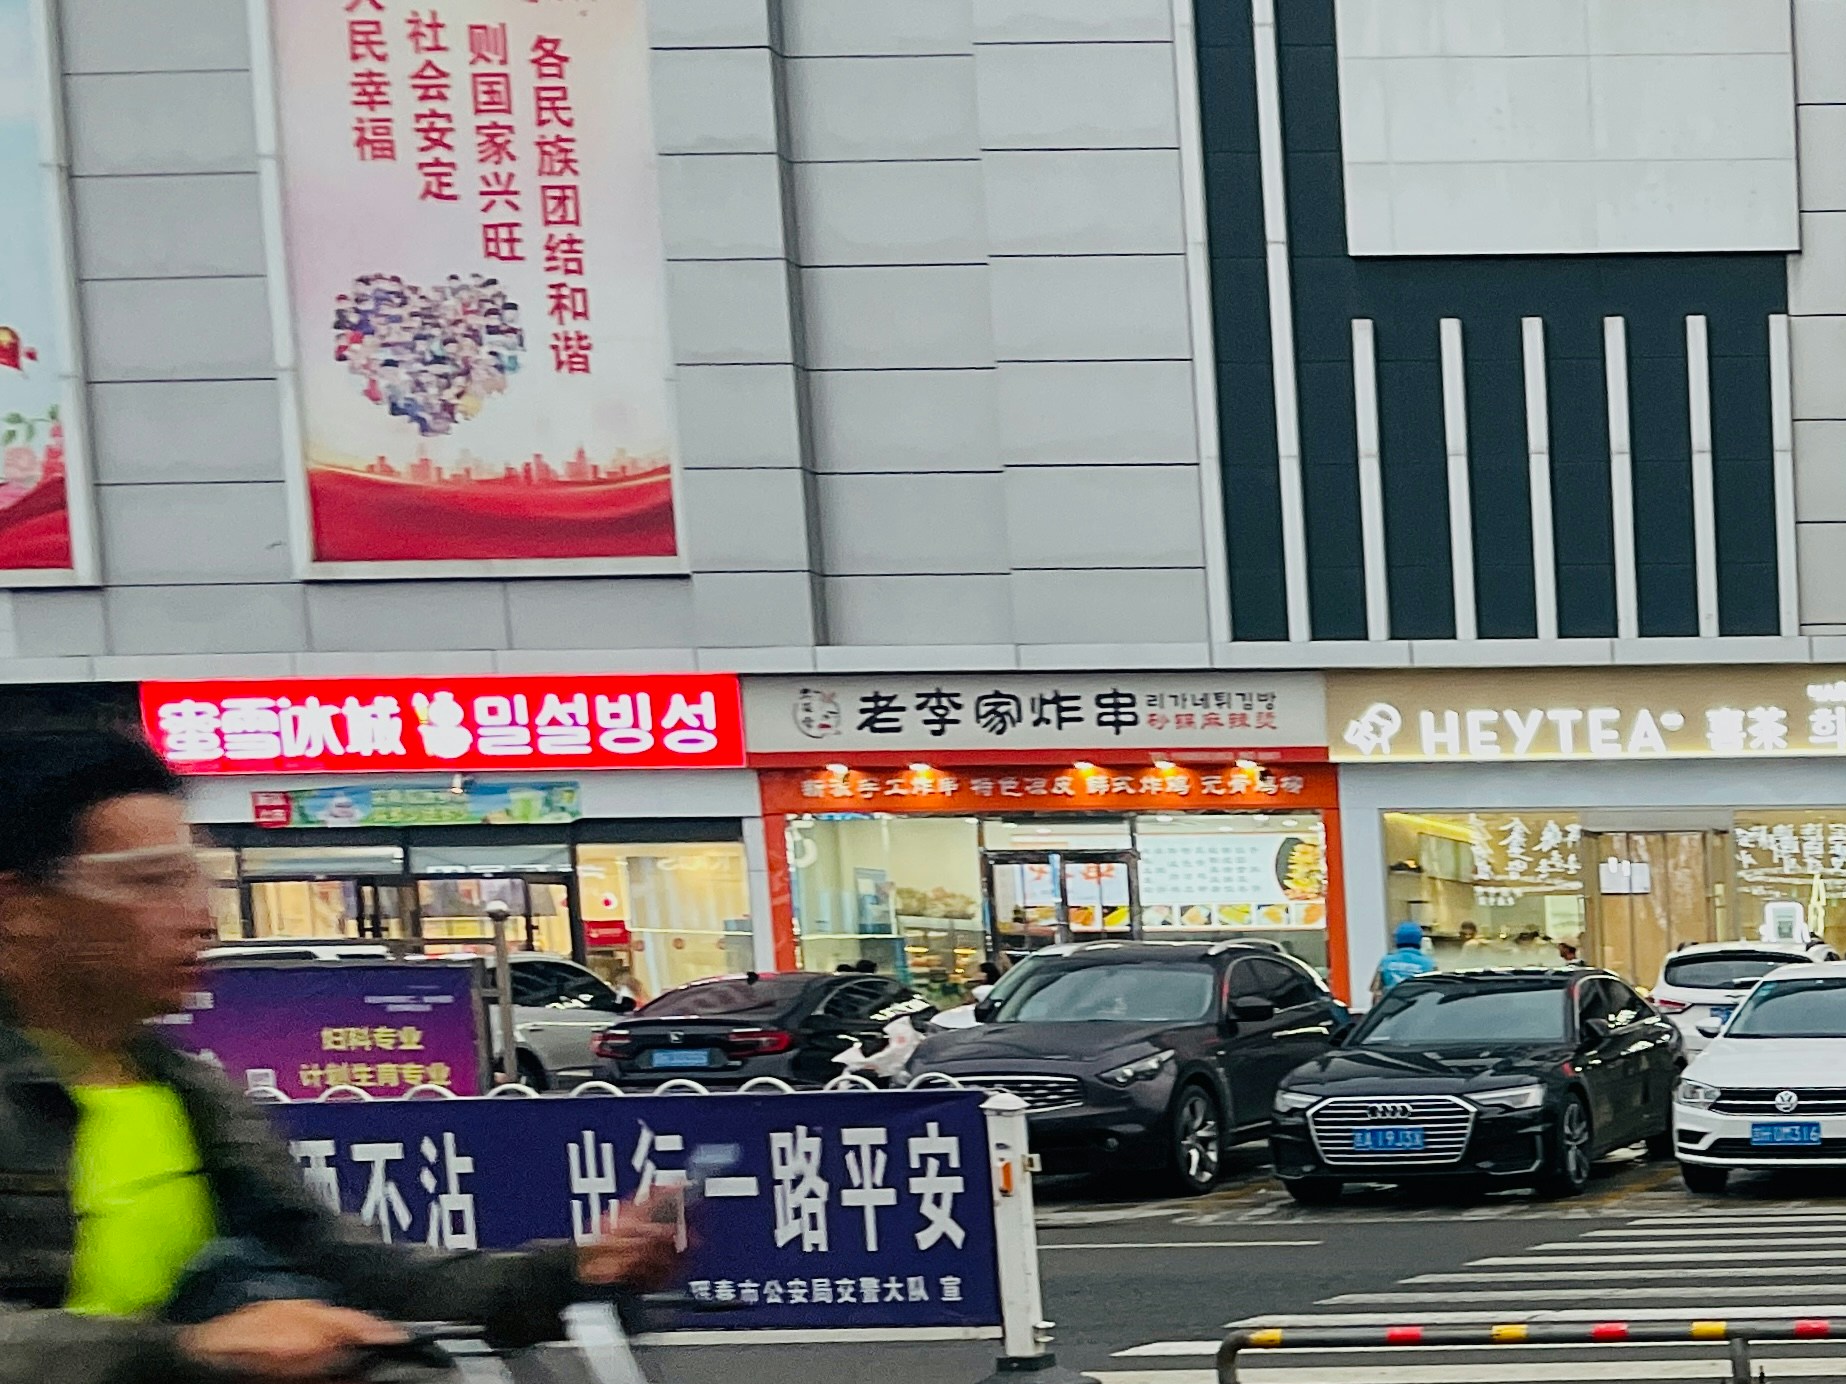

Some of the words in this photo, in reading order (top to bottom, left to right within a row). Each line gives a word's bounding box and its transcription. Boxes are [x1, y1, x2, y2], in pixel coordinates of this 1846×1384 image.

[405, 10, 461, 202] 社会安定
[467, 22, 527, 263] 则国家兴旺
[529, 34, 594, 375] 各民族团结和谐
[157, 695, 405, 762] 蜜雪冰城
[473, 690, 718, 755] 밀설빙성
[856, 687, 1139, 736] 老李家炸串
[1418, 707, 1668, 755] HEYTEA
[566, 1118, 966, 1254] 出行一路平安
[939, 1275, 964, 1302] 宣
